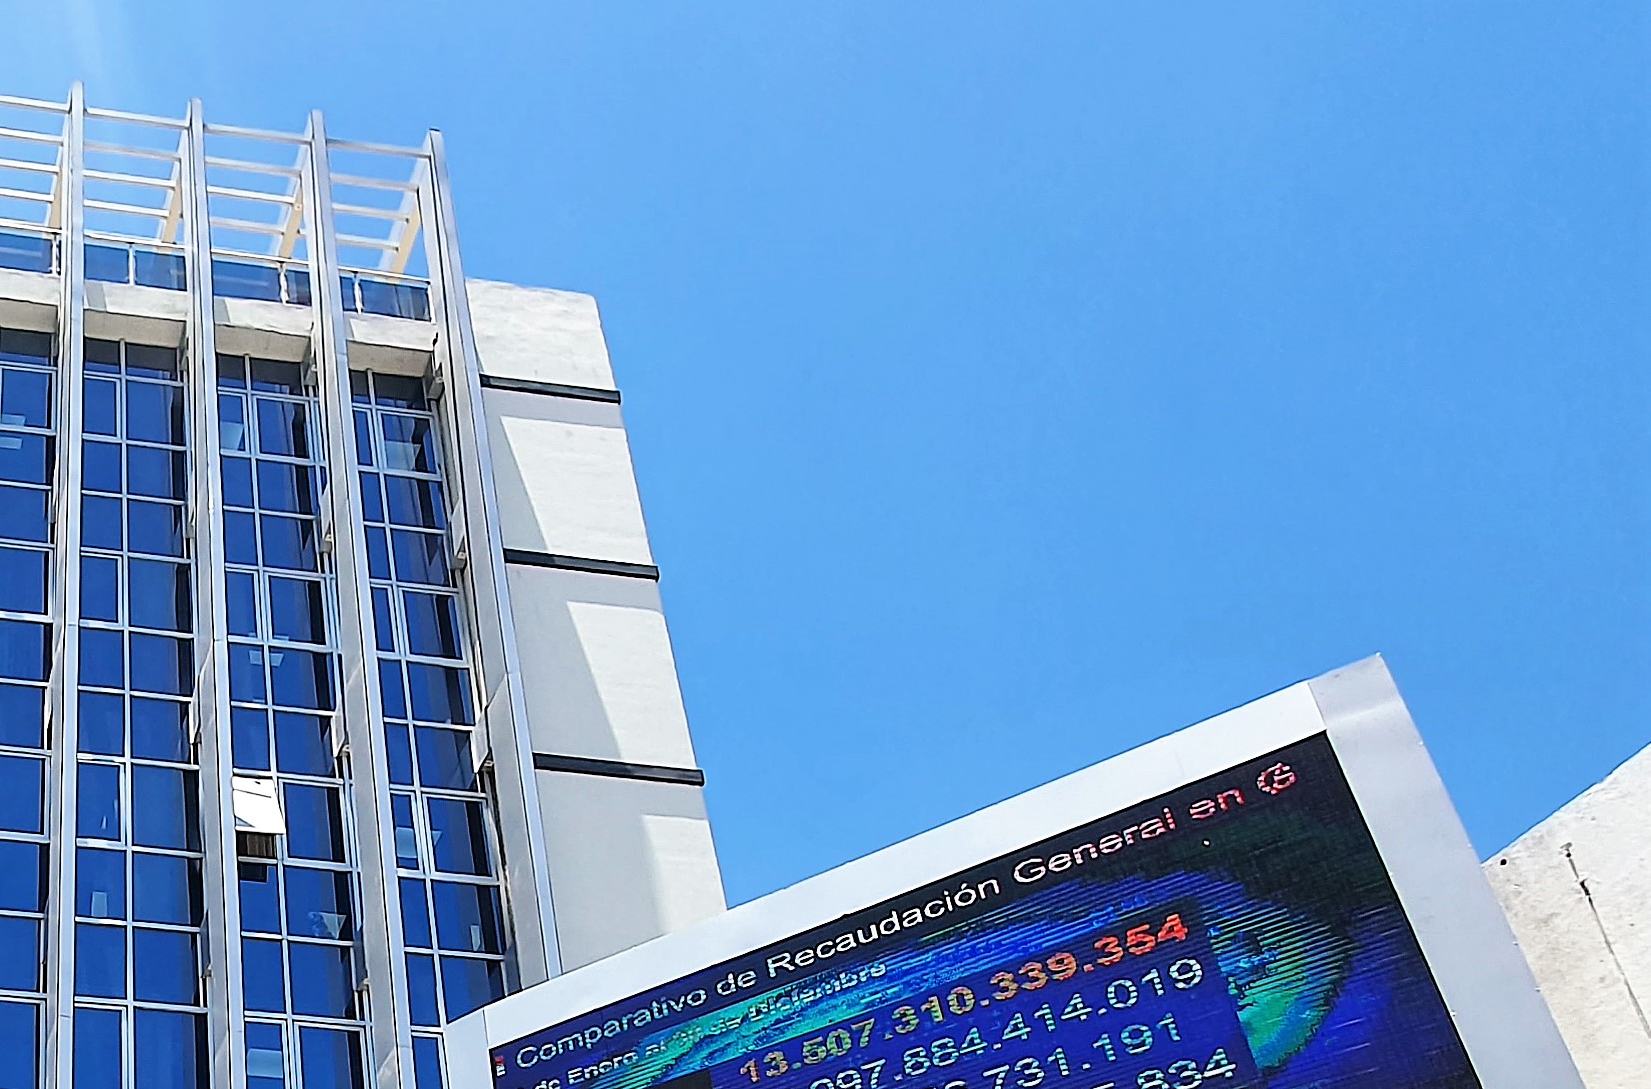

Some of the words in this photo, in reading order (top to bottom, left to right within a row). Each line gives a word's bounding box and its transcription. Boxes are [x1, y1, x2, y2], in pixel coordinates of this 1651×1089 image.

[516, 989, 707, 1068] Comparativo
[717, 970, 757, 996] de
[766, 878, 1000, 978] Recaudación
[1013, 807, 1176, 884] General
[1190, 788, 1245, 819] en
[740, 913, 1189, 1082] 13.507.310.339.354
[568, 1051, 639, 1084] Enero
[749, 963, 887, 1021] Diciembre
